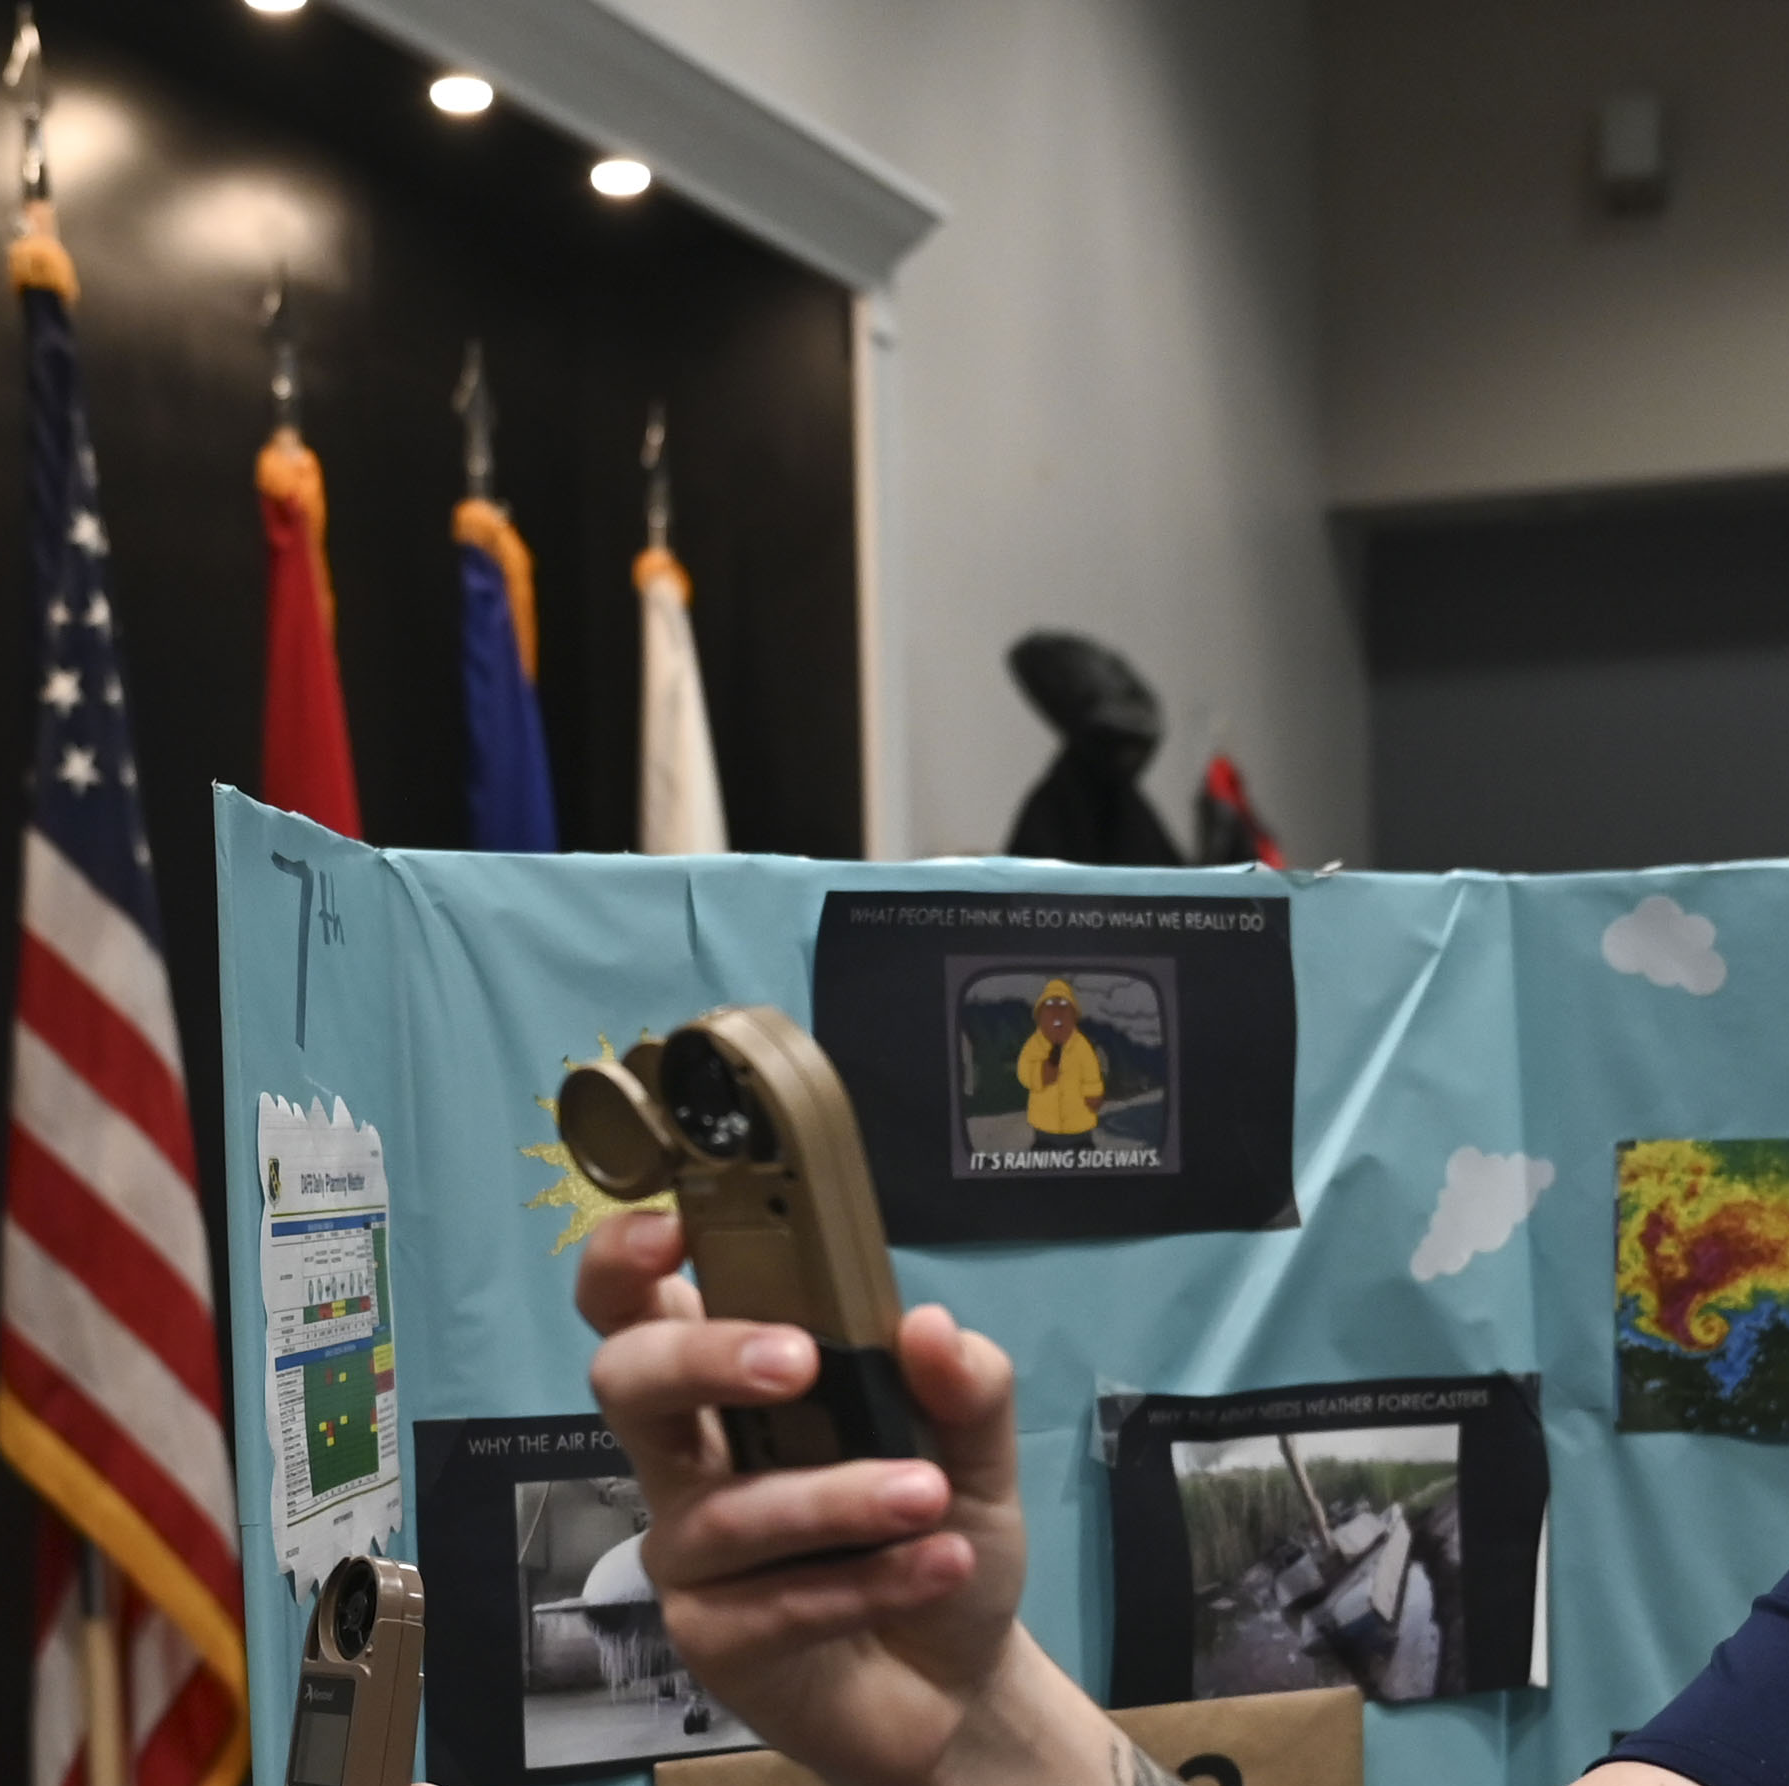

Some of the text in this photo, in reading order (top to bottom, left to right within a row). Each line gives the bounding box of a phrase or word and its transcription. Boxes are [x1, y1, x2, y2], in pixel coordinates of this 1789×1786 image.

[849, 906, 1265, 932] WHAT PEOPLE THINK WE DO AND WHAT WE REALLY DO
[1003, 1150, 1075, 1170] RAINING
[1308, 1394, 1373, 1416] WEATHER
[1377, 1389, 1490, 1413] FORECASTERS
[468, 1431, 621, 1456] WHY THE AIR FO
